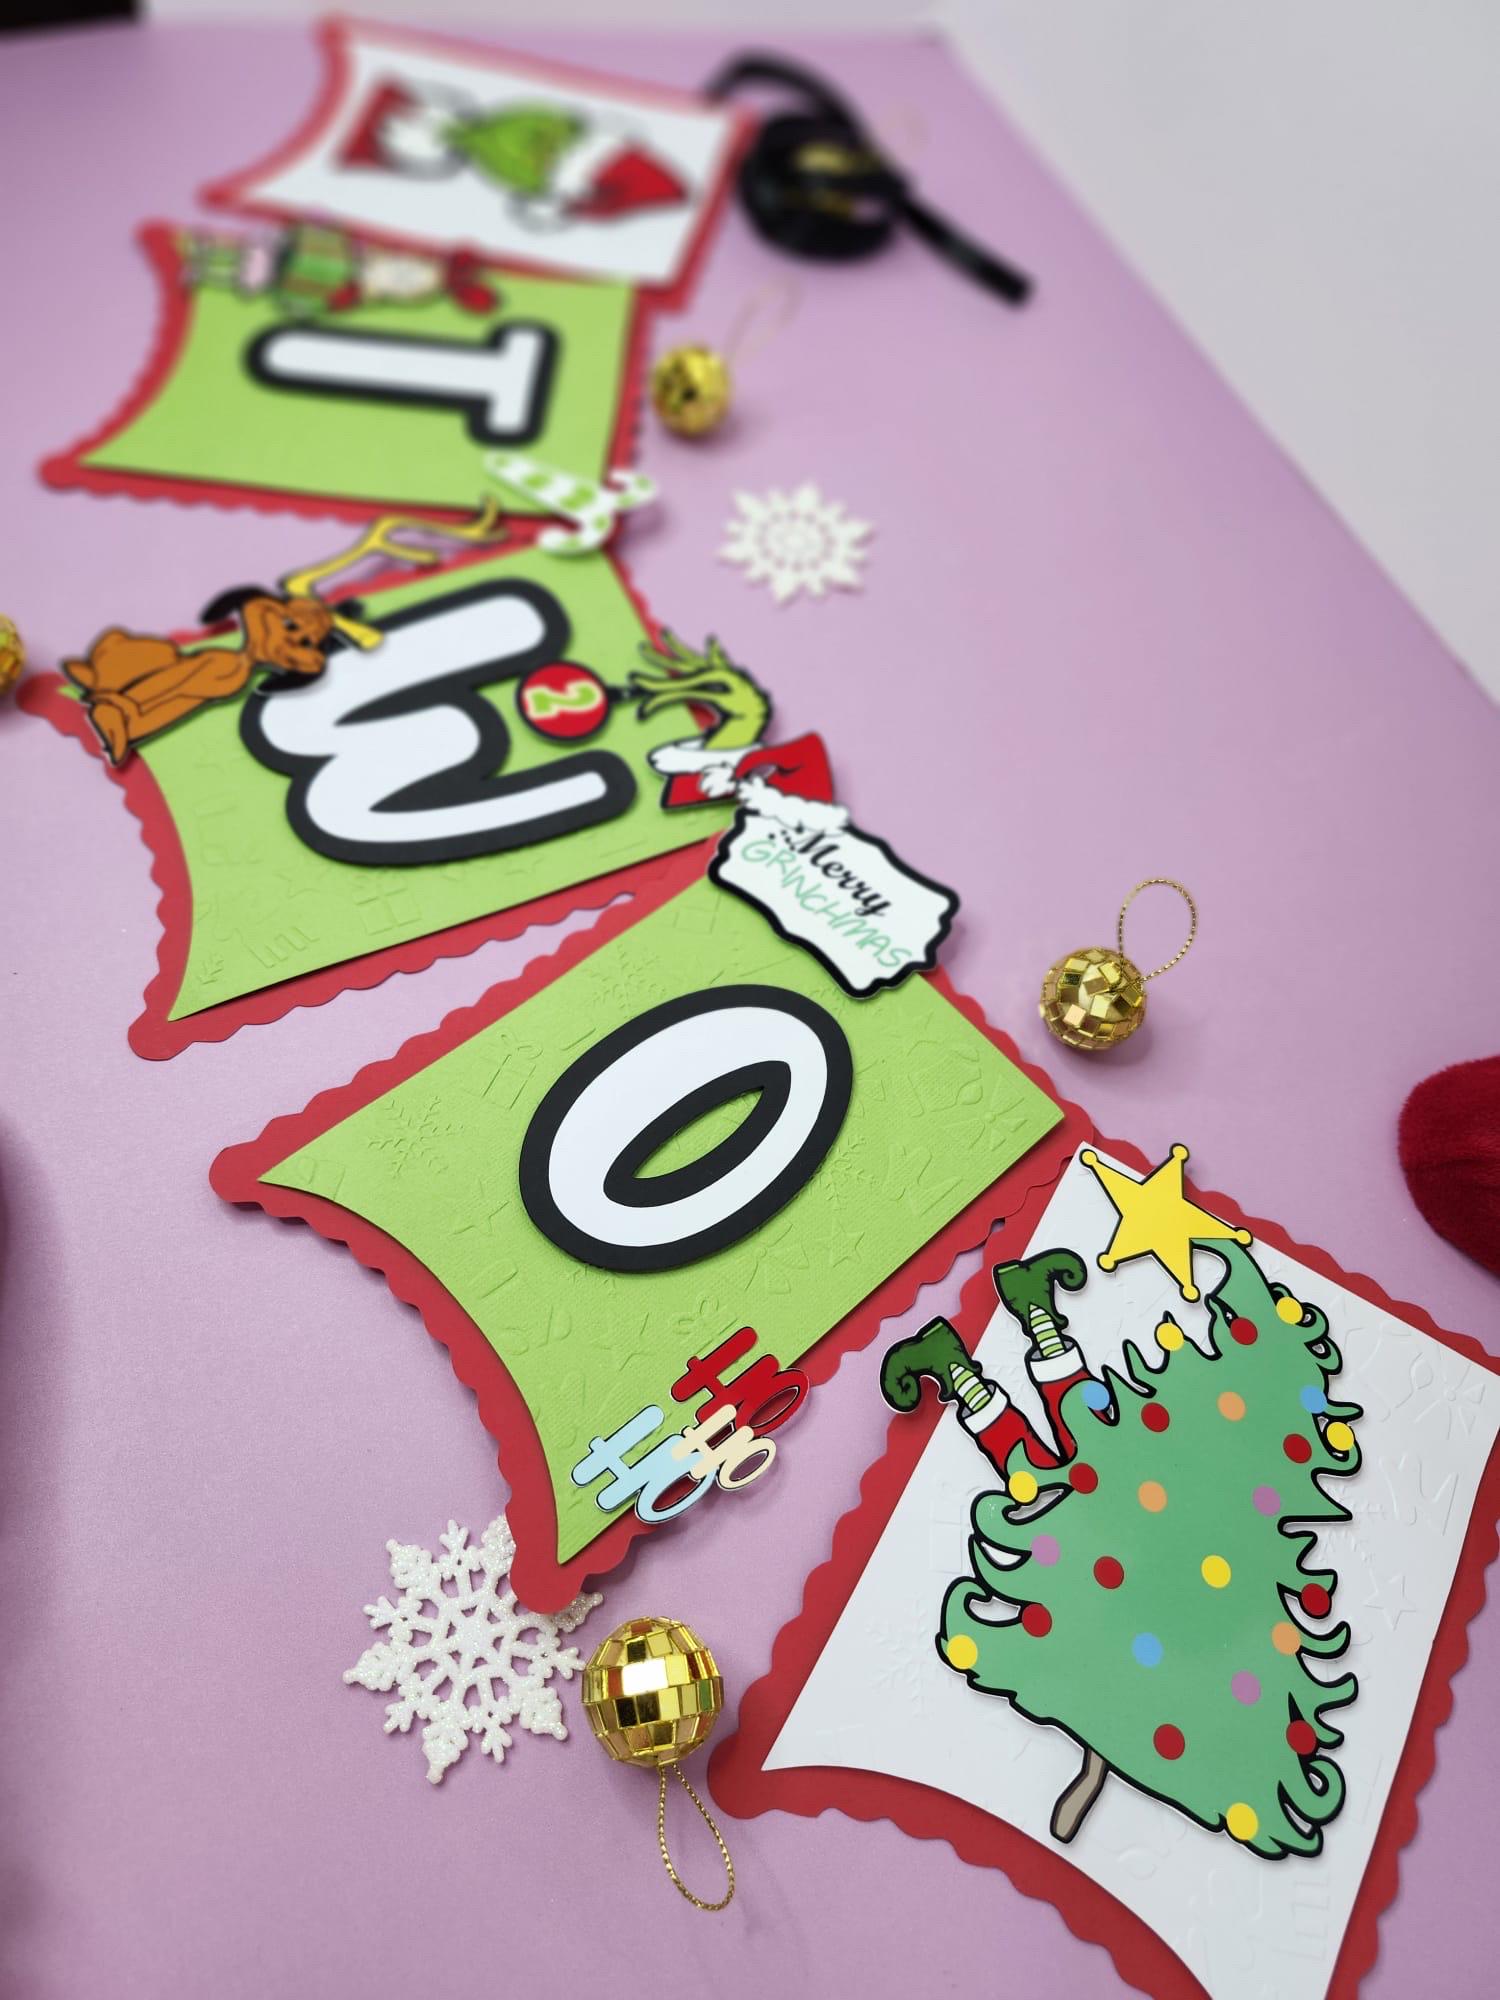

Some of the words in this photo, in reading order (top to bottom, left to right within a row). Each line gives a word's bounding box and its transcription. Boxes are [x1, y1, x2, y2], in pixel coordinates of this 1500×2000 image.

[523, 682, 604, 718] 2
[741, 839, 912, 968] GRINCHMAS
[767, 826, 892, 918] Merry
